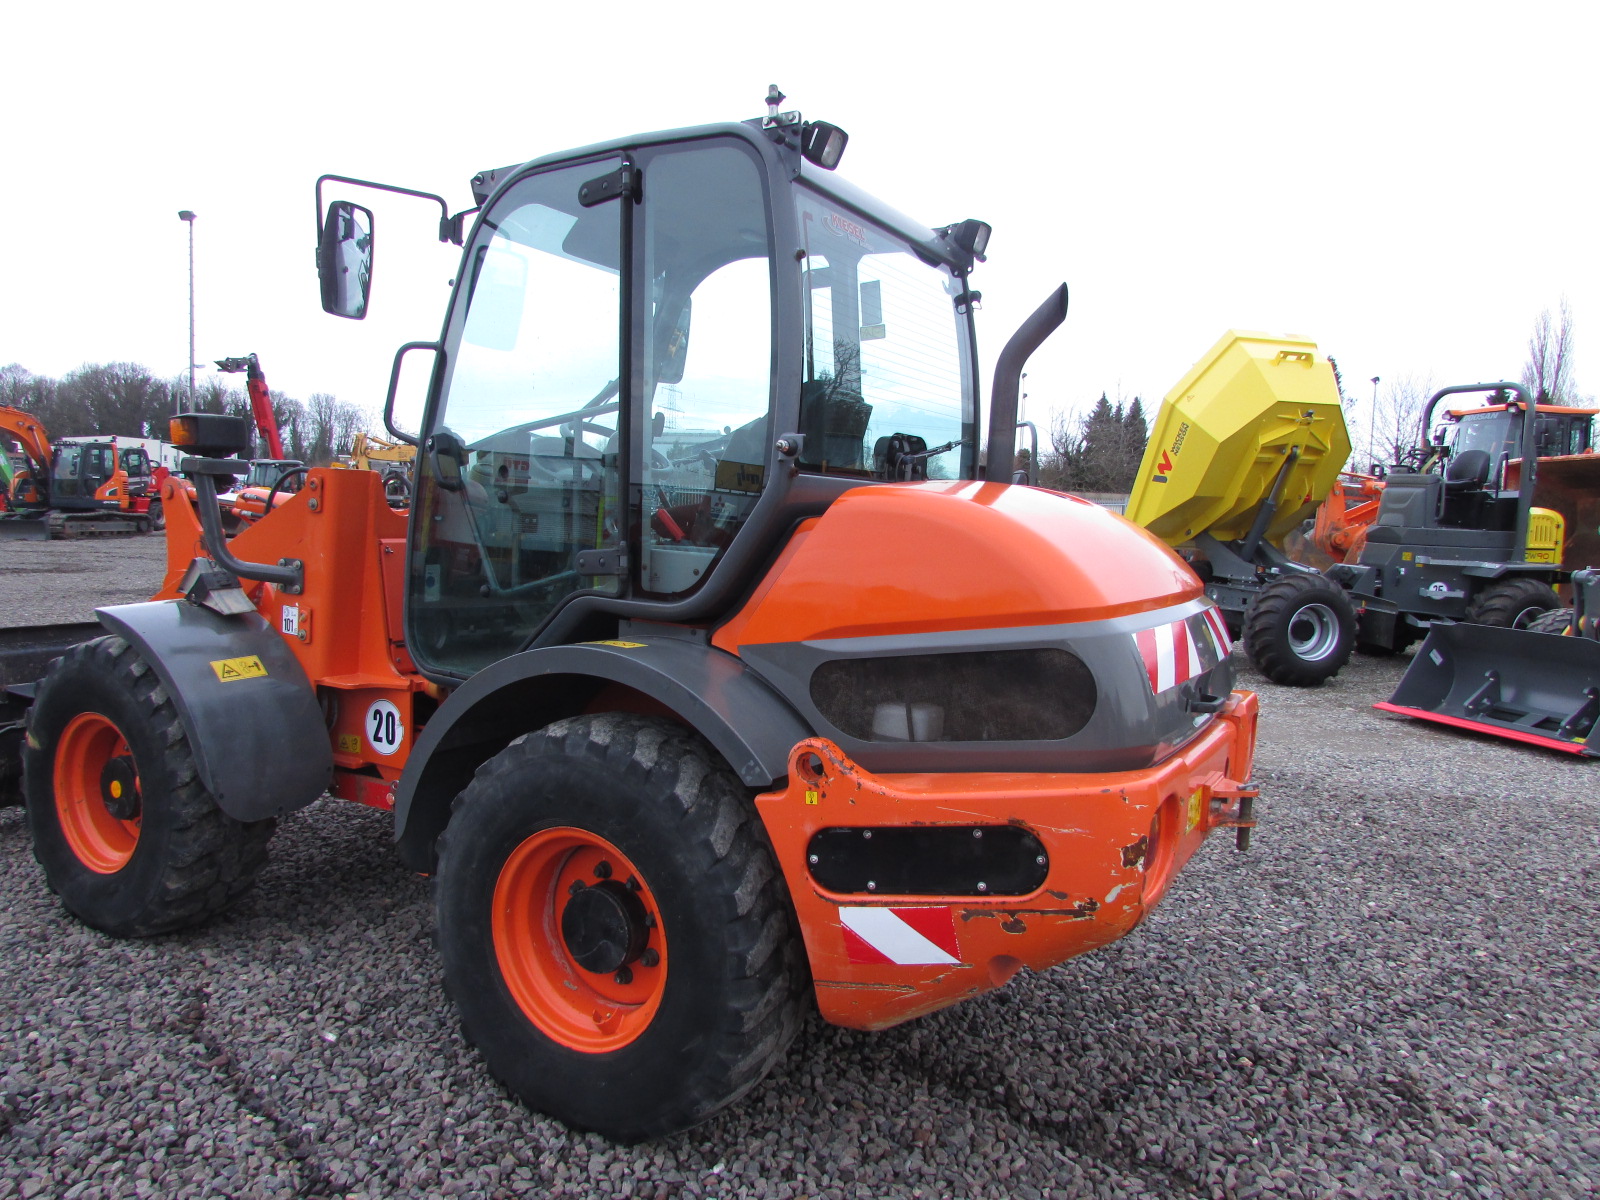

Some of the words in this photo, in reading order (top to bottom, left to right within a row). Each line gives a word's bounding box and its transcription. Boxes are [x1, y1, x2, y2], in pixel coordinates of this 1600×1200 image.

[1173, 423, 1190, 457] NEUSON
[284, 618, 294, 632] 101
[373, 708, 396, 746] 20
